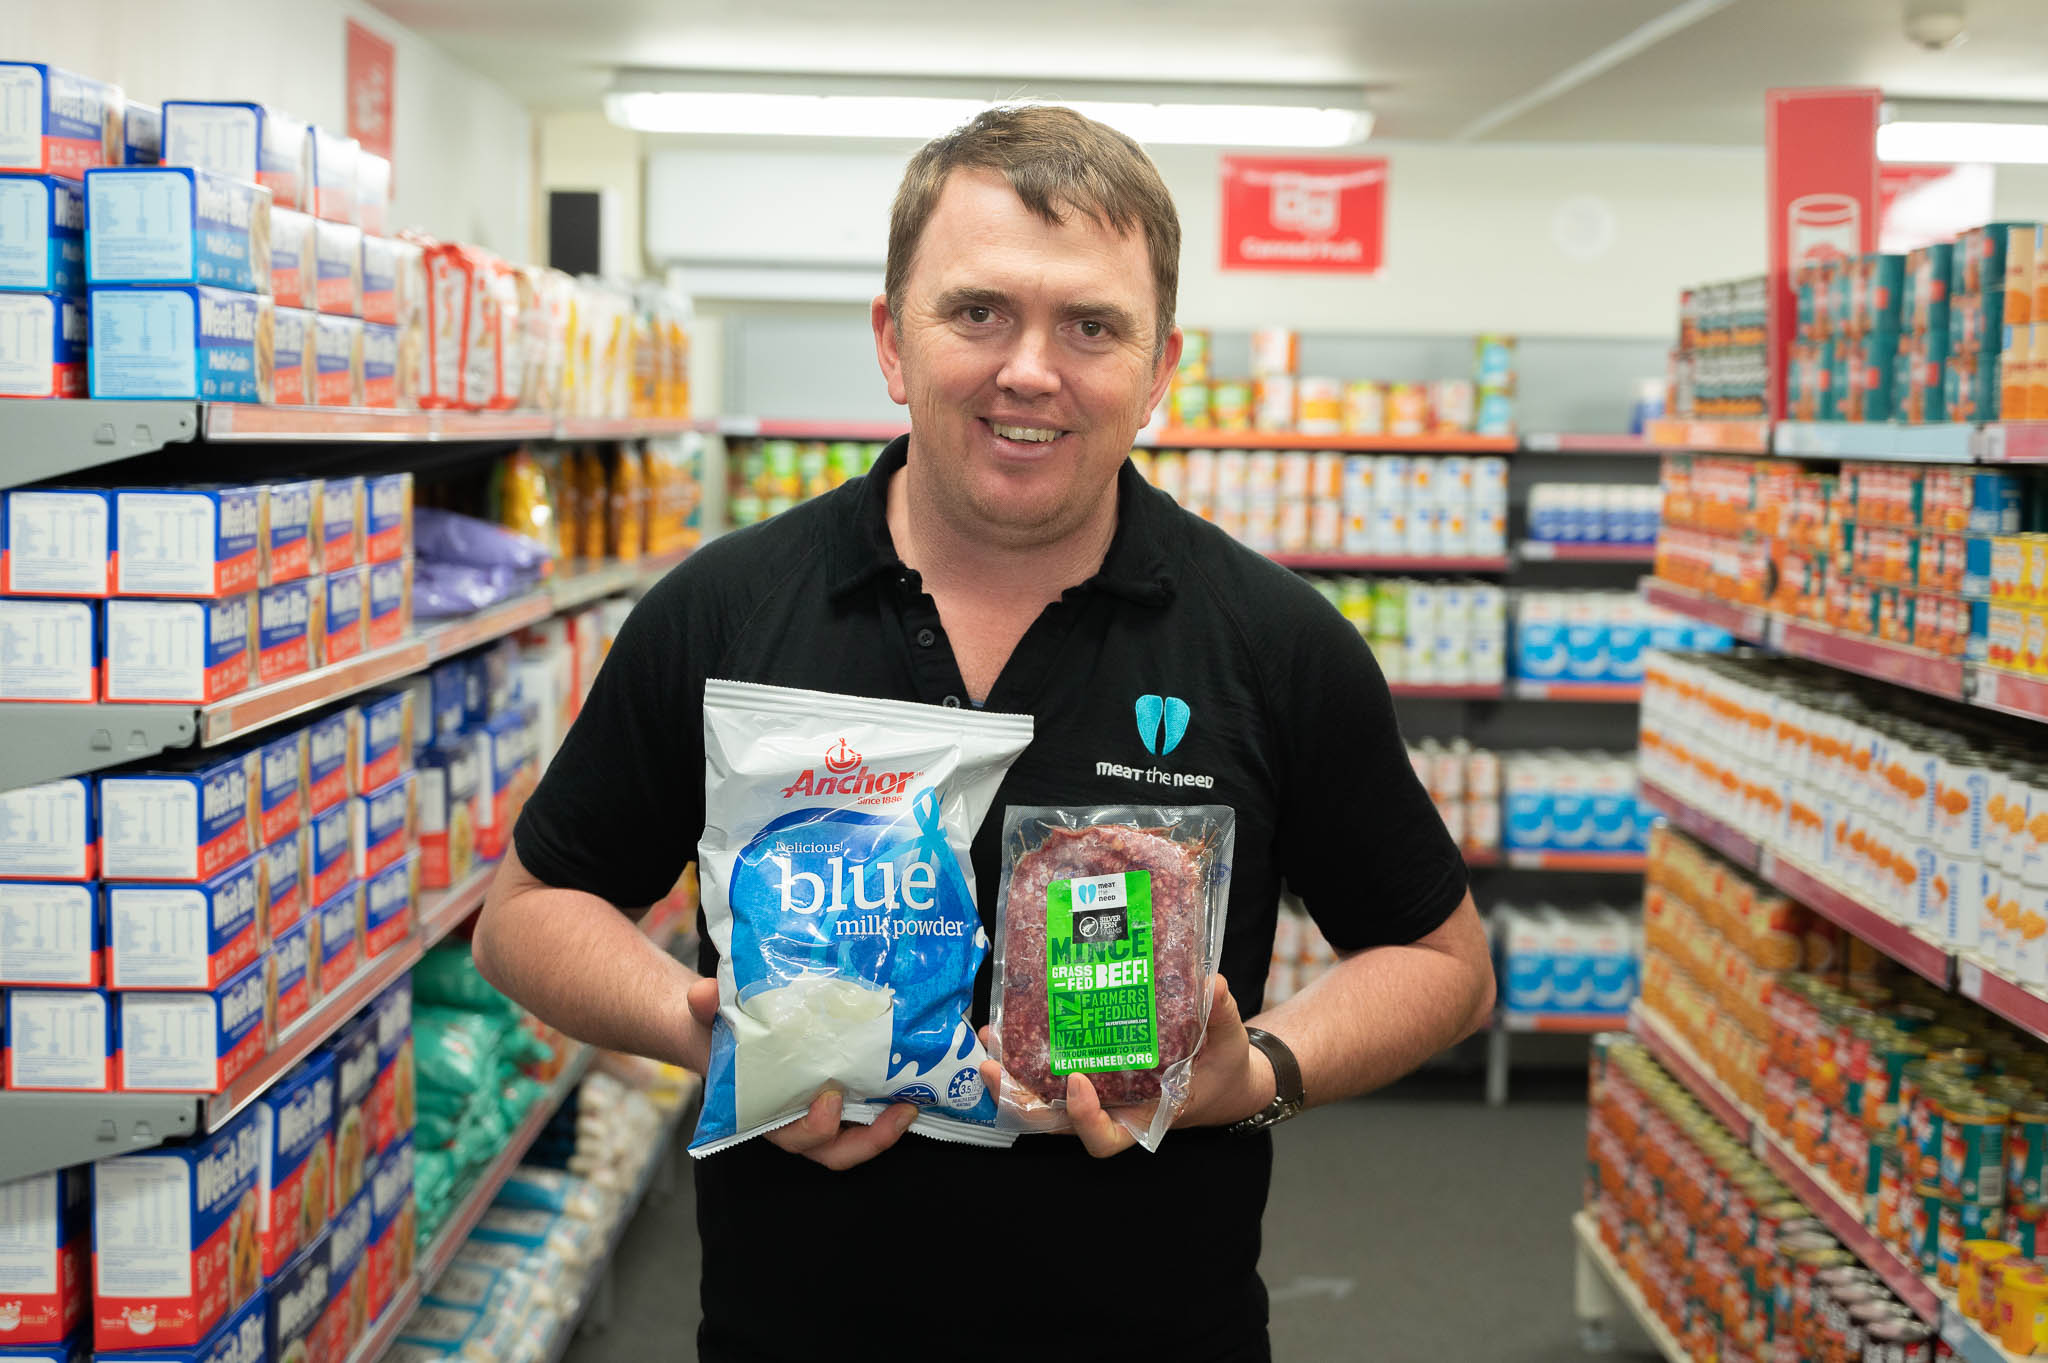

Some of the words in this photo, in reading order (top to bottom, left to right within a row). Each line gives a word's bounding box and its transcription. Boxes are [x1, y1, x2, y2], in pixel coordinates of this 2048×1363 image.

[780, 766, 915, 798] Anchor
[1145, 766, 1172, 785] the
[857, 796, 881, 805] Since
[882, 796, 903, 804] 1886
[775, 840, 844, 854] Delicious!
[775, 856, 936, 914] blue
[836, 915, 888, 935] milk
[893, 916, 964, 939] powder
[1100, 915, 1121, 923] SILVER
[1100, 921, 1118, 929] FERN
[1052, 928, 1147, 965] MINCE
[1052, 965, 1093, 978] GRASS
[1096, 959, 1148, 988] BEEF!
[1082, 988, 1145, 1007] FARMERS
[1082, 1003, 1147, 1029] FEEDING
